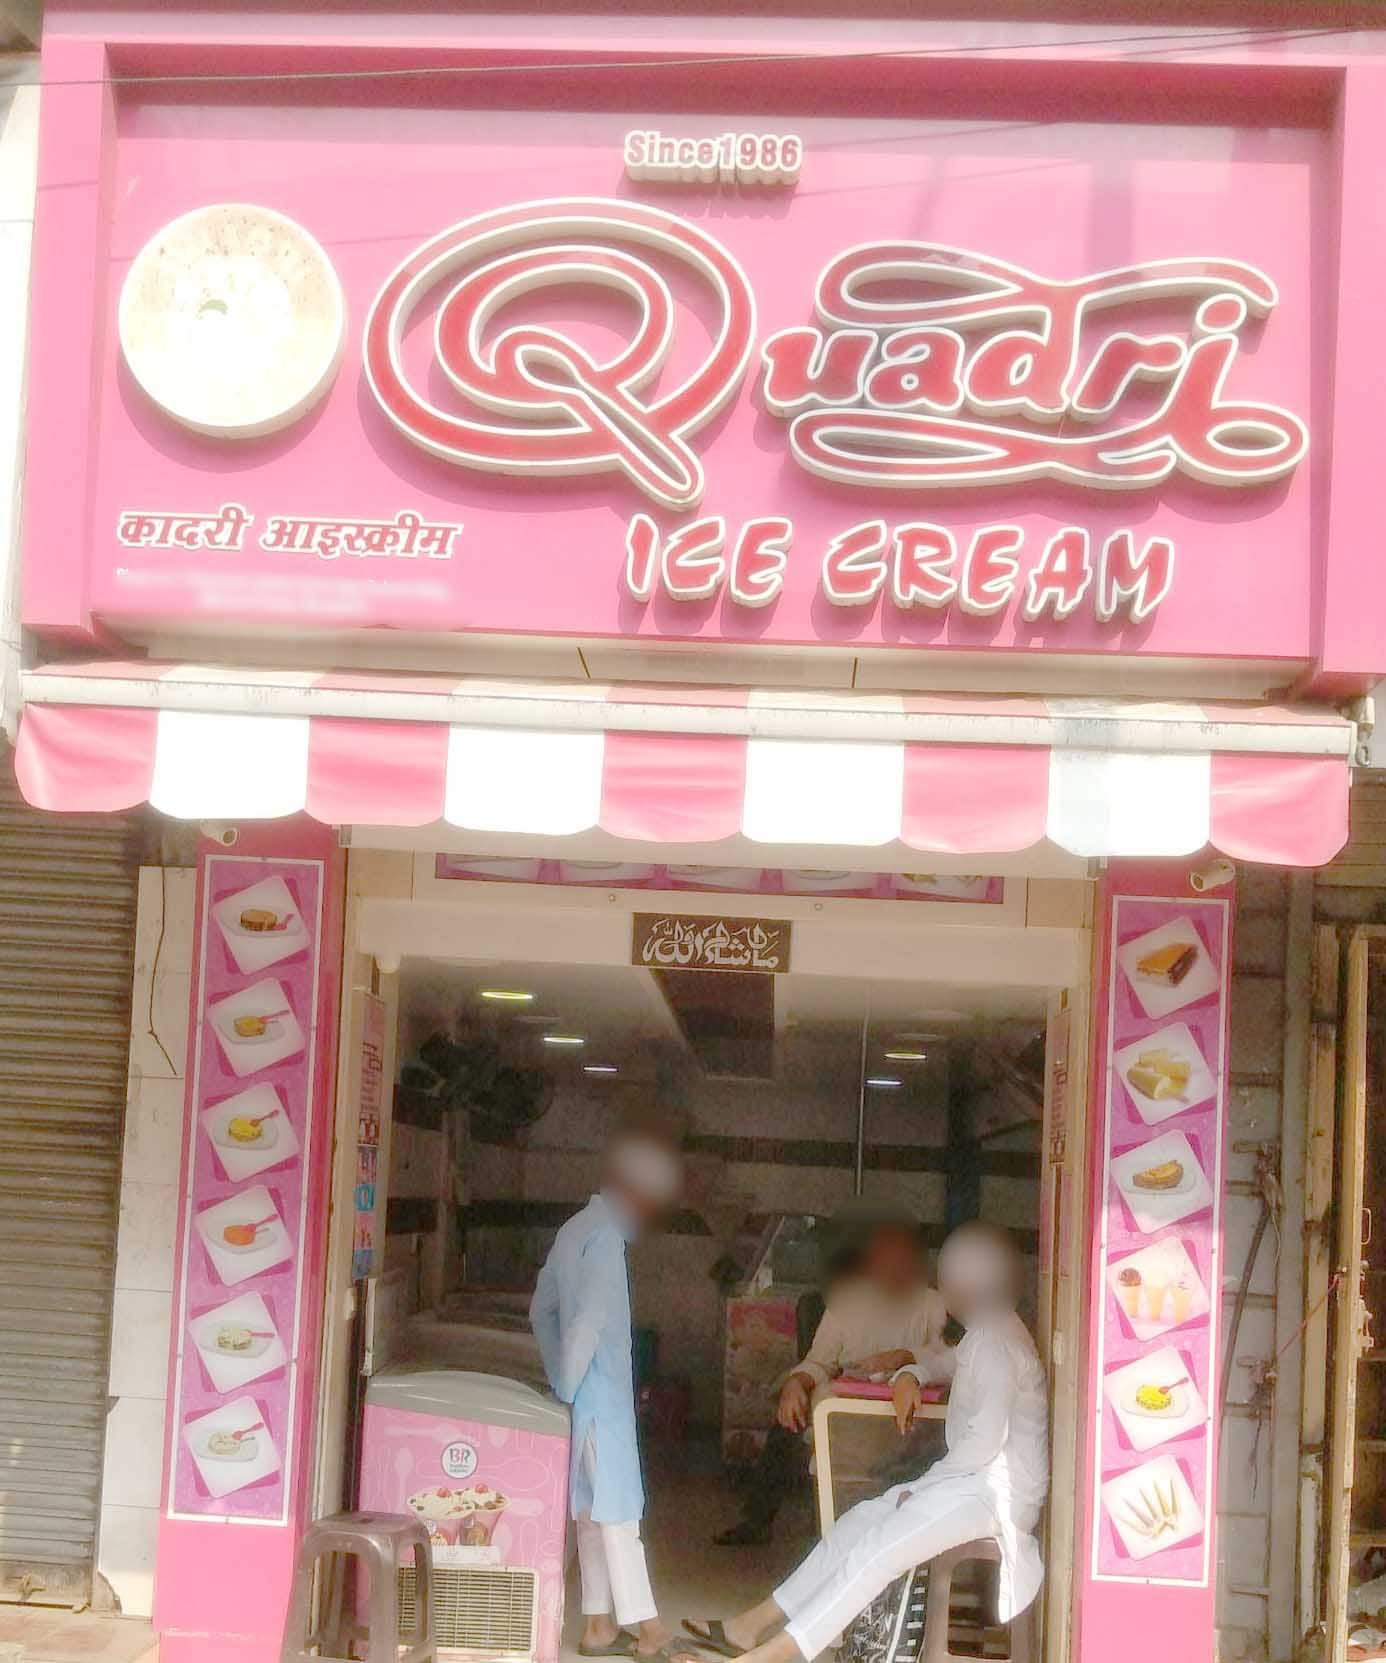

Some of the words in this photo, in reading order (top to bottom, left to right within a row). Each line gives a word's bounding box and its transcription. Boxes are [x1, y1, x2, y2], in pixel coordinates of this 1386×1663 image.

[362, 196, 1310, 506] Quadri
[117, 503, 254, 551] कादरी
[625, 513, 794, 606] ICE
[822, 519, 1176, 622] CREAM
